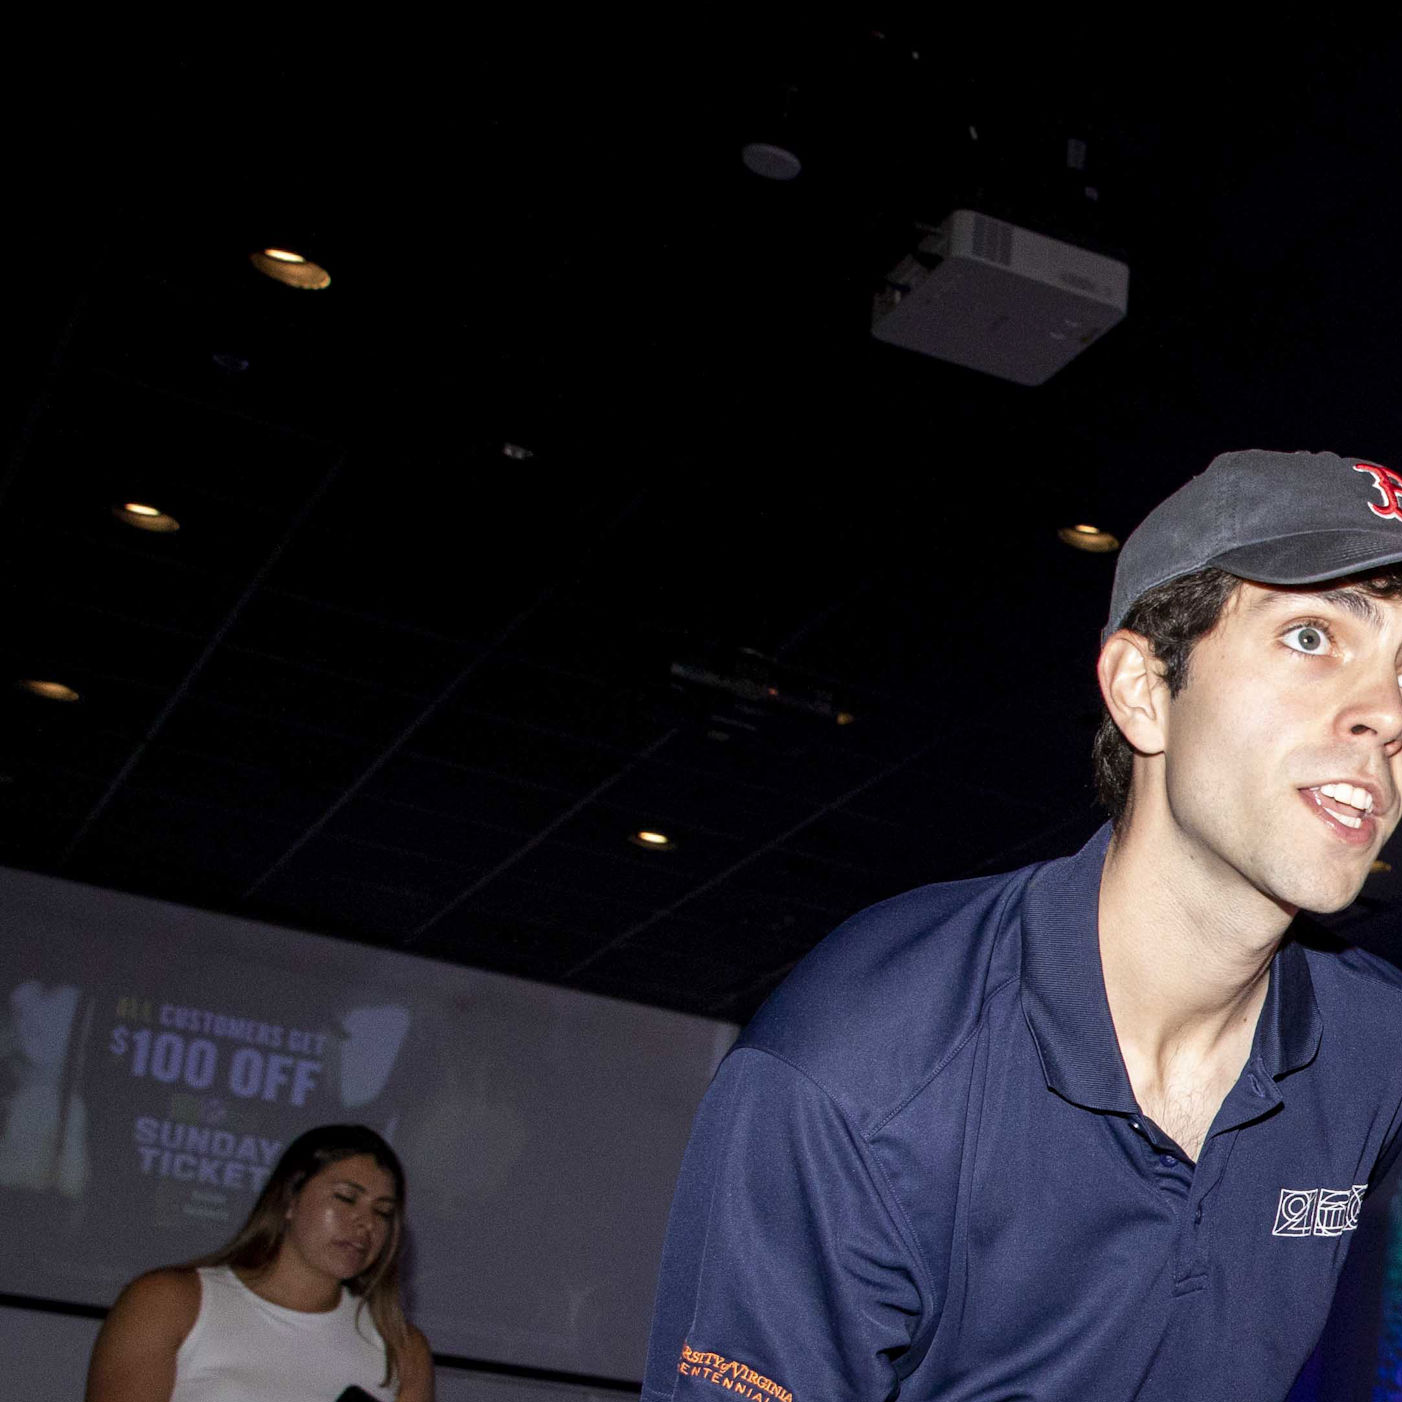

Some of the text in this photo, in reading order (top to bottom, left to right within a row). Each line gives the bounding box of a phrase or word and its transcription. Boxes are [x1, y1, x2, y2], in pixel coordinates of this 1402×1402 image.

[109, 1025, 323, 1107] $100 OFF
[135, 1115, 283, 1165] SUNDAY
[137, 1147, 272, 1193] TICKET
